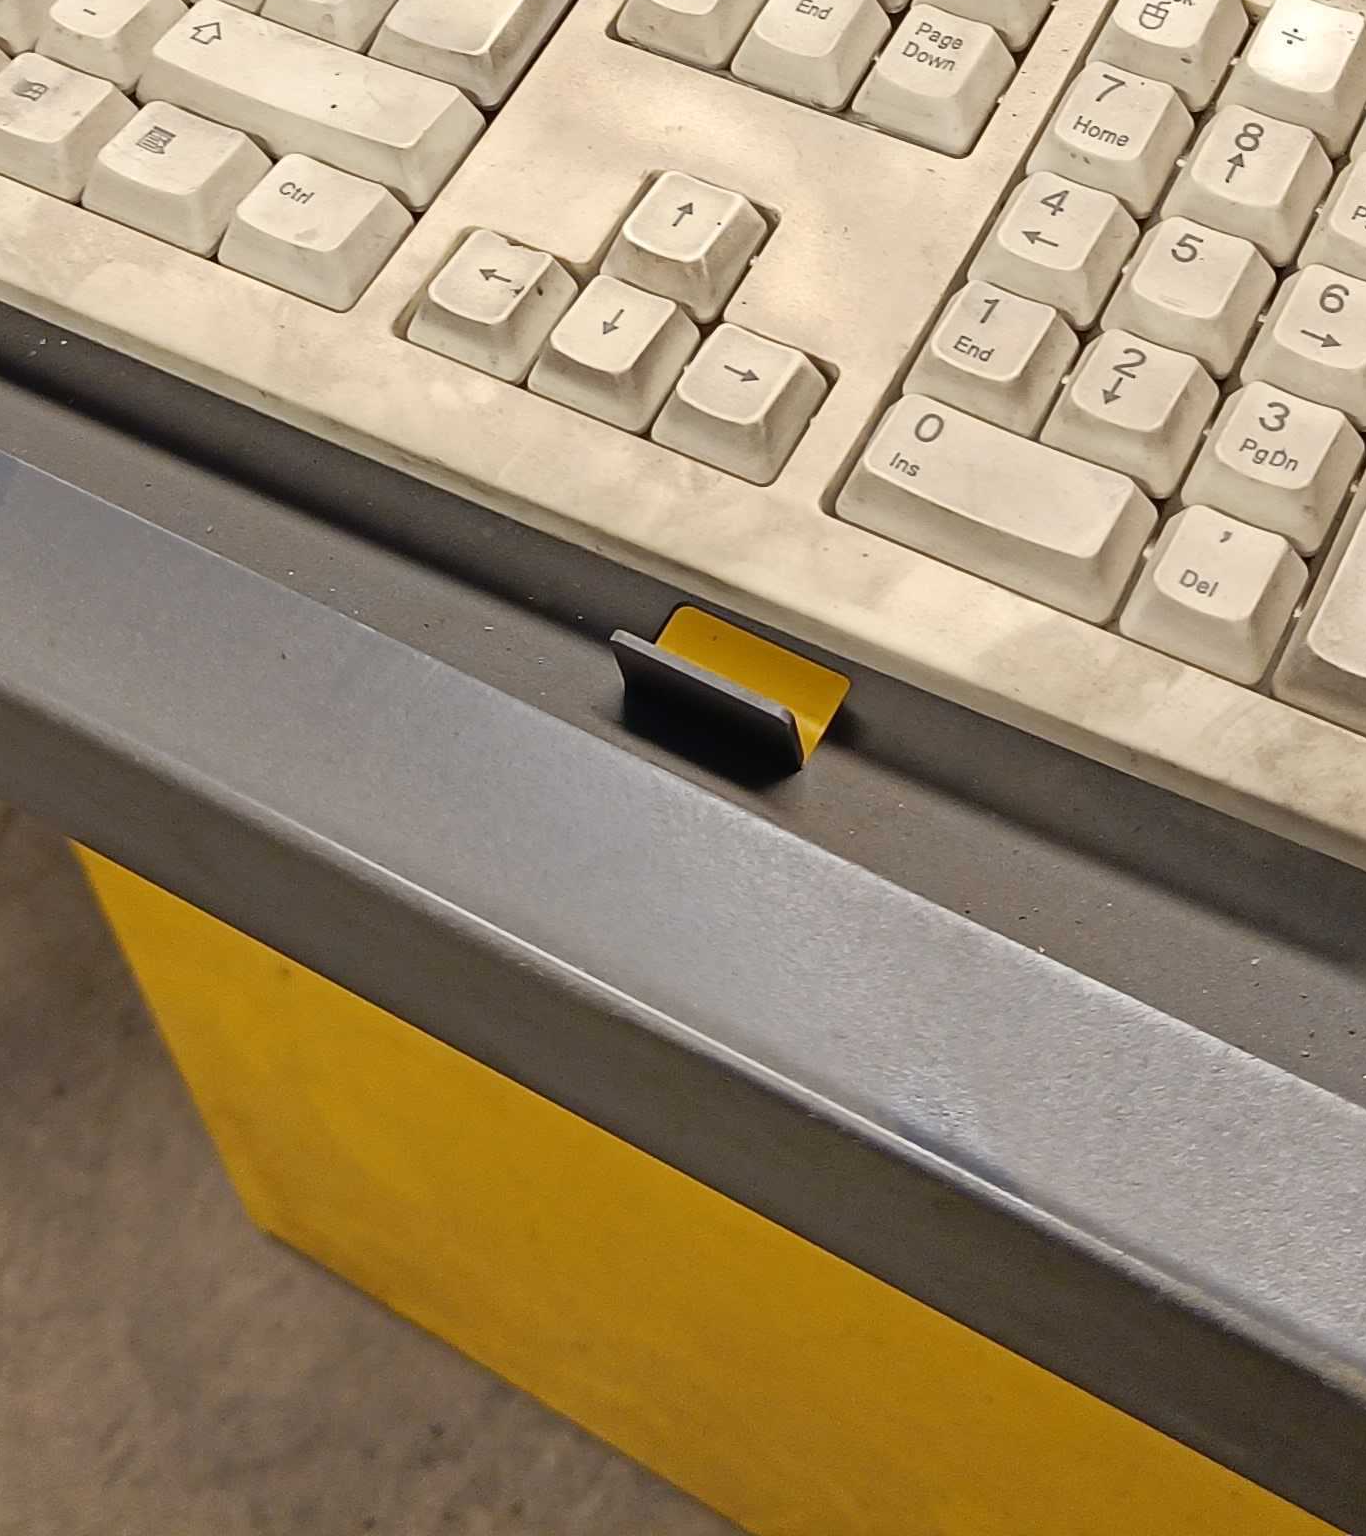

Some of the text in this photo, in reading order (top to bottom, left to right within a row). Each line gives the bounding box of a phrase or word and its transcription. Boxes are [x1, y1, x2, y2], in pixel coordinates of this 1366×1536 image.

[915, 22, 964, 51] Page
[901, 41, 956, 73] Down
[1096, 73, 1126, 103] 7
[1072, 115, 1130, 147] Home
[1235, 122, 1265, 152] 8
[279, 181, 315, 205] Ctrl
[1040, 189, 1069, 216] 4
[1171, 234, 1204, 263] 5
[981, 298, 1002, 324] 1
[1319, 284, 1350, 313] 6
[953, 335, 995, 362] End
[1113, 348, 1147, 379] 2
[914, 413, 945, 443] 0
[1258, 401, 1291, 432] 3
[889, 451, 921, 477] Ins
[1179, 568, 1219, 598] Del
